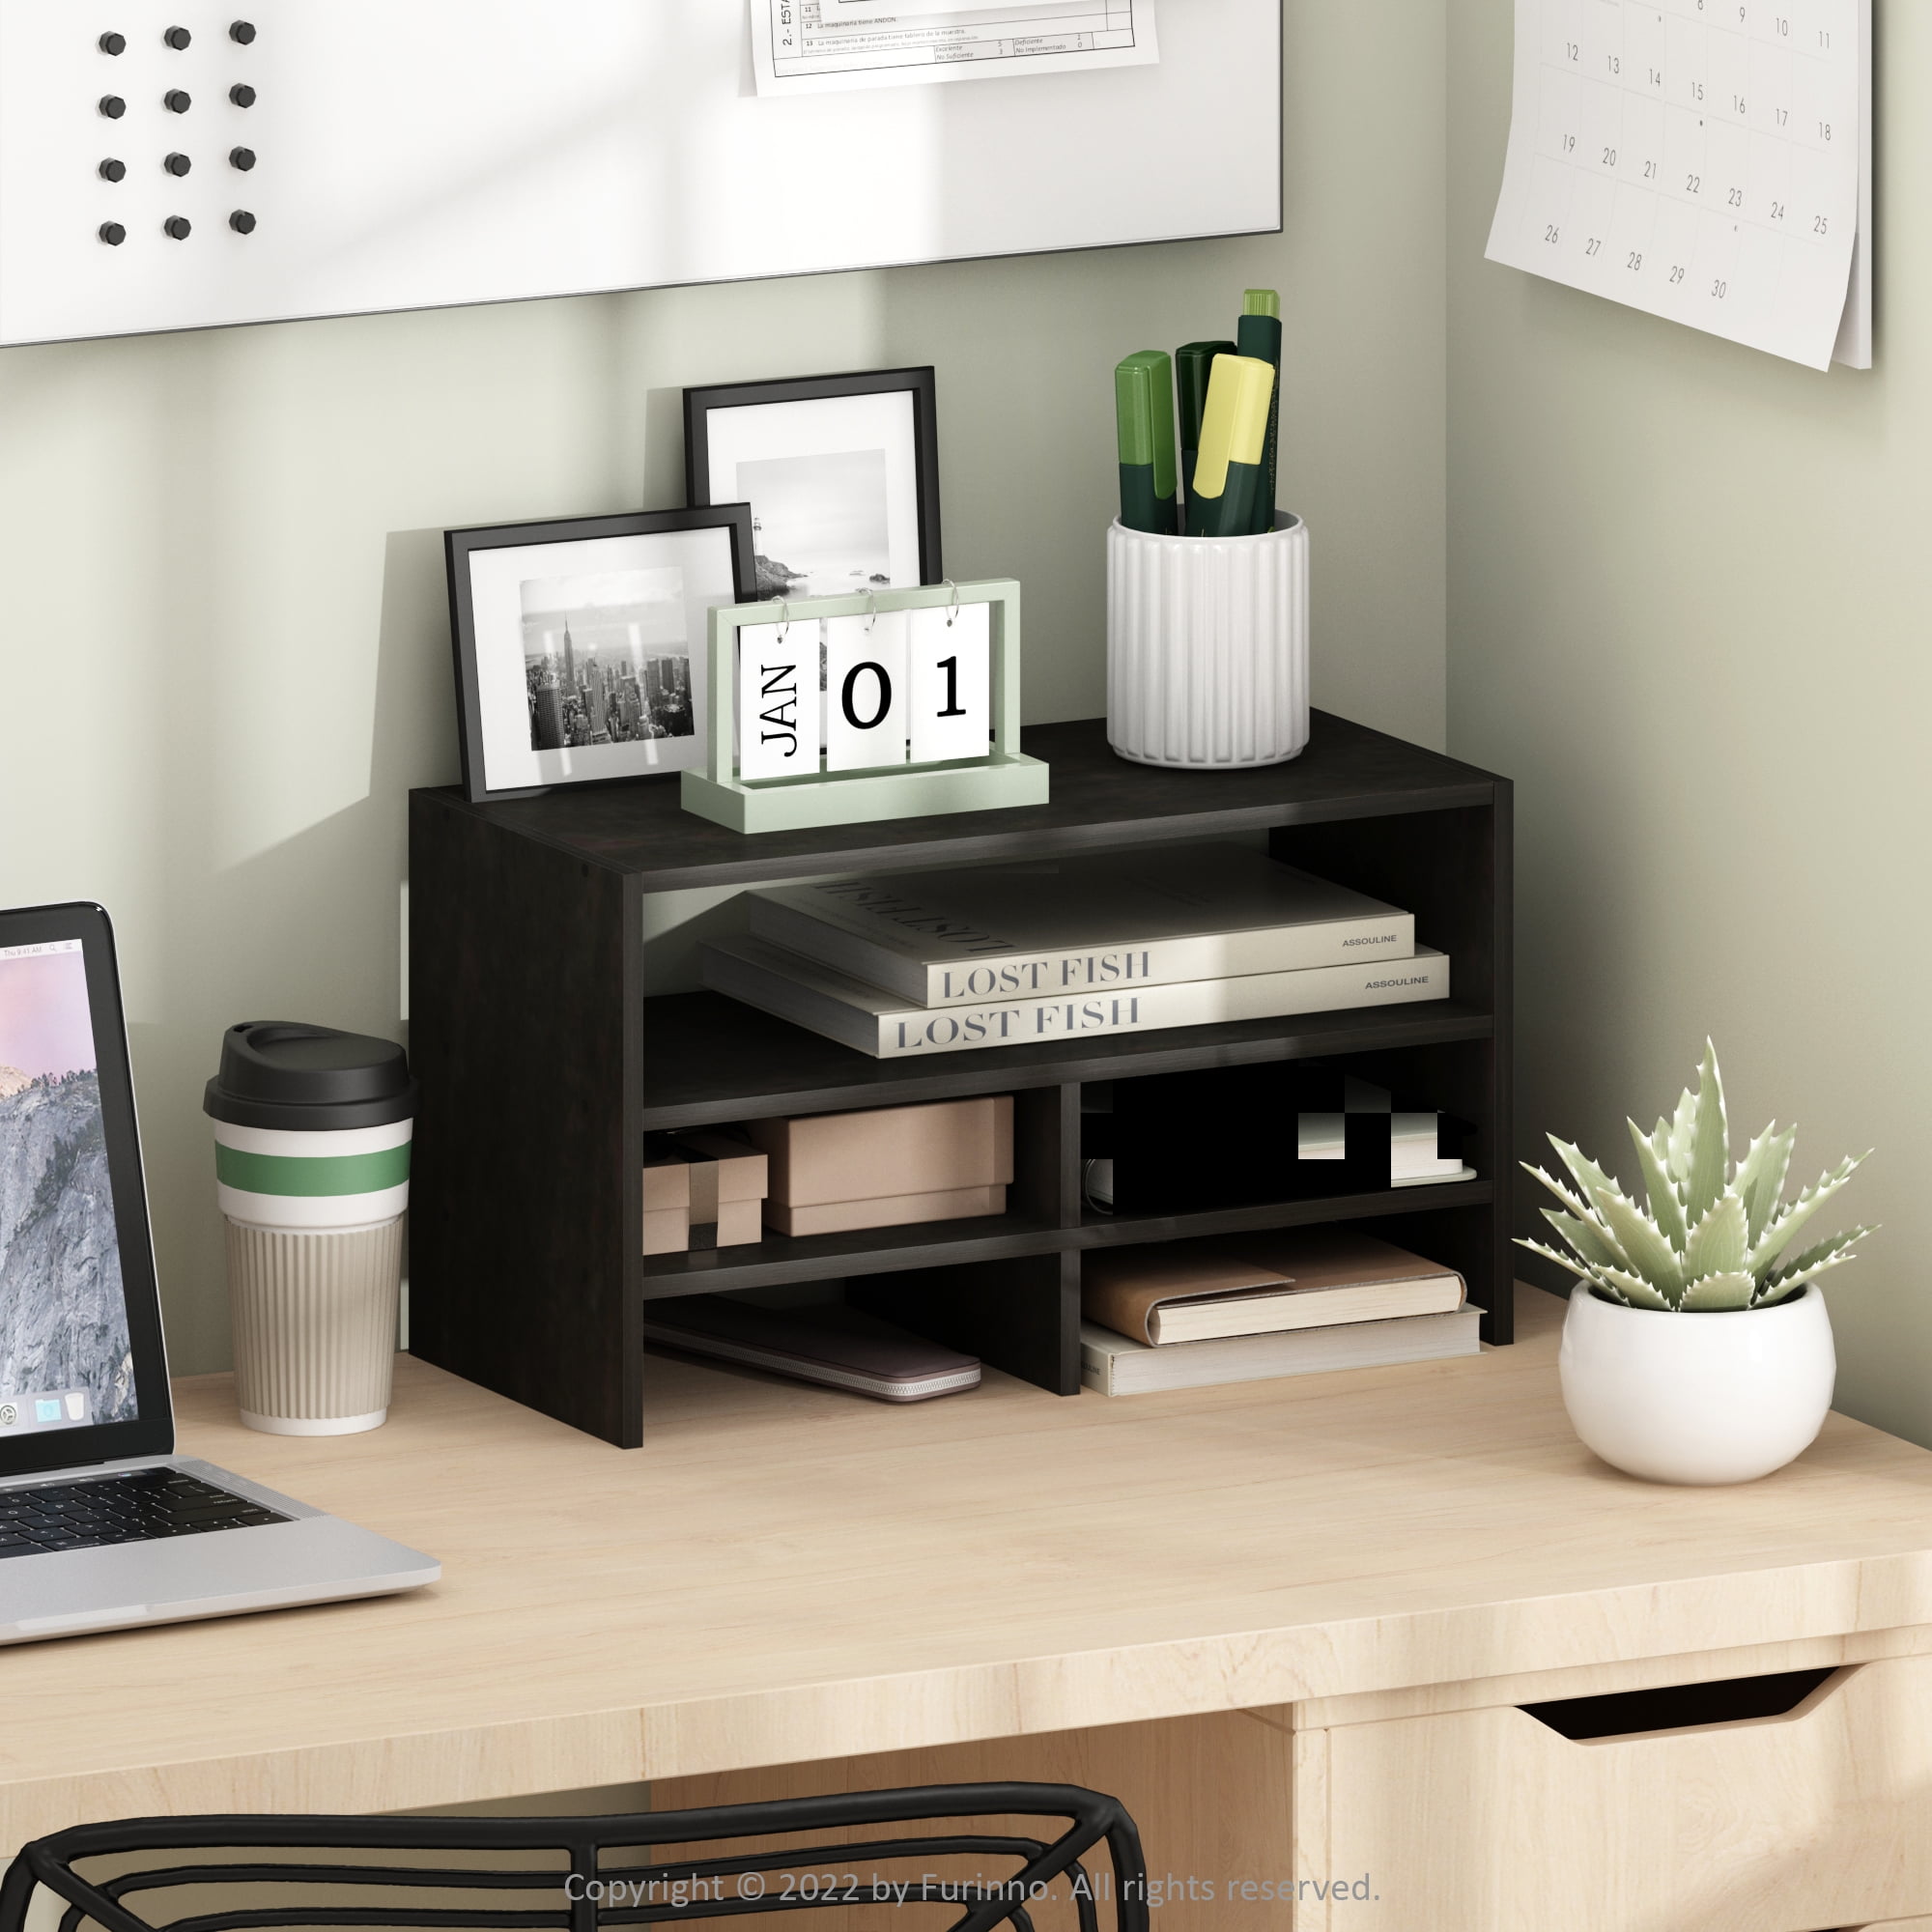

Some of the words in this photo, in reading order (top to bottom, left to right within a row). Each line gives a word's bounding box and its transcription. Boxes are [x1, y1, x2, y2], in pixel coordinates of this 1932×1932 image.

[1739, 6, 1746, 23] 9
[1776, 17, 1788, 37] 10
[1819, 30, 1830, 48] 11
[1566, 42, 1578, 62] 12
[1607, 55, 1620, 74] 13
[1649, 69, 1661, 87] 14
[1691, 81, 1704, 101] 15
[1733, 95, 1746, 115] 16
[1776, 108, 1788, 127] 17
[1818, 122, 1832, 141] 18
[1563, 133, 1576, 153] 19
[1602, 147, 1616, 167] 20
[1643, 160, 1657, 180] 21
[1686, 174, 1700, 194] 22
[1727, 187, 1743, 208] 23
[1770, 201, 1784, 220] 24
[1813, 214, 1828, 236] 25
[1544, 224, 1560, 244] 26
[1585, 238, 1602, 256] 27
[1626, 251, 1642, 271] 28
[1668, 265, 1685, 285] 29
[1711, 278, 1726, 299] 30
[758, 664, 798, 758] JAN
[941, 961, 1048, 999] LOST
[1059, 951, 1151, 987] FISH
[1342, 934, 1398, 948] ASSOULINE
[895, 1009, 1020, 1049] LOST
[1035, 996, 1142, 1035] FISH
[1365, 976, 1430, 990] ASSOULINE
